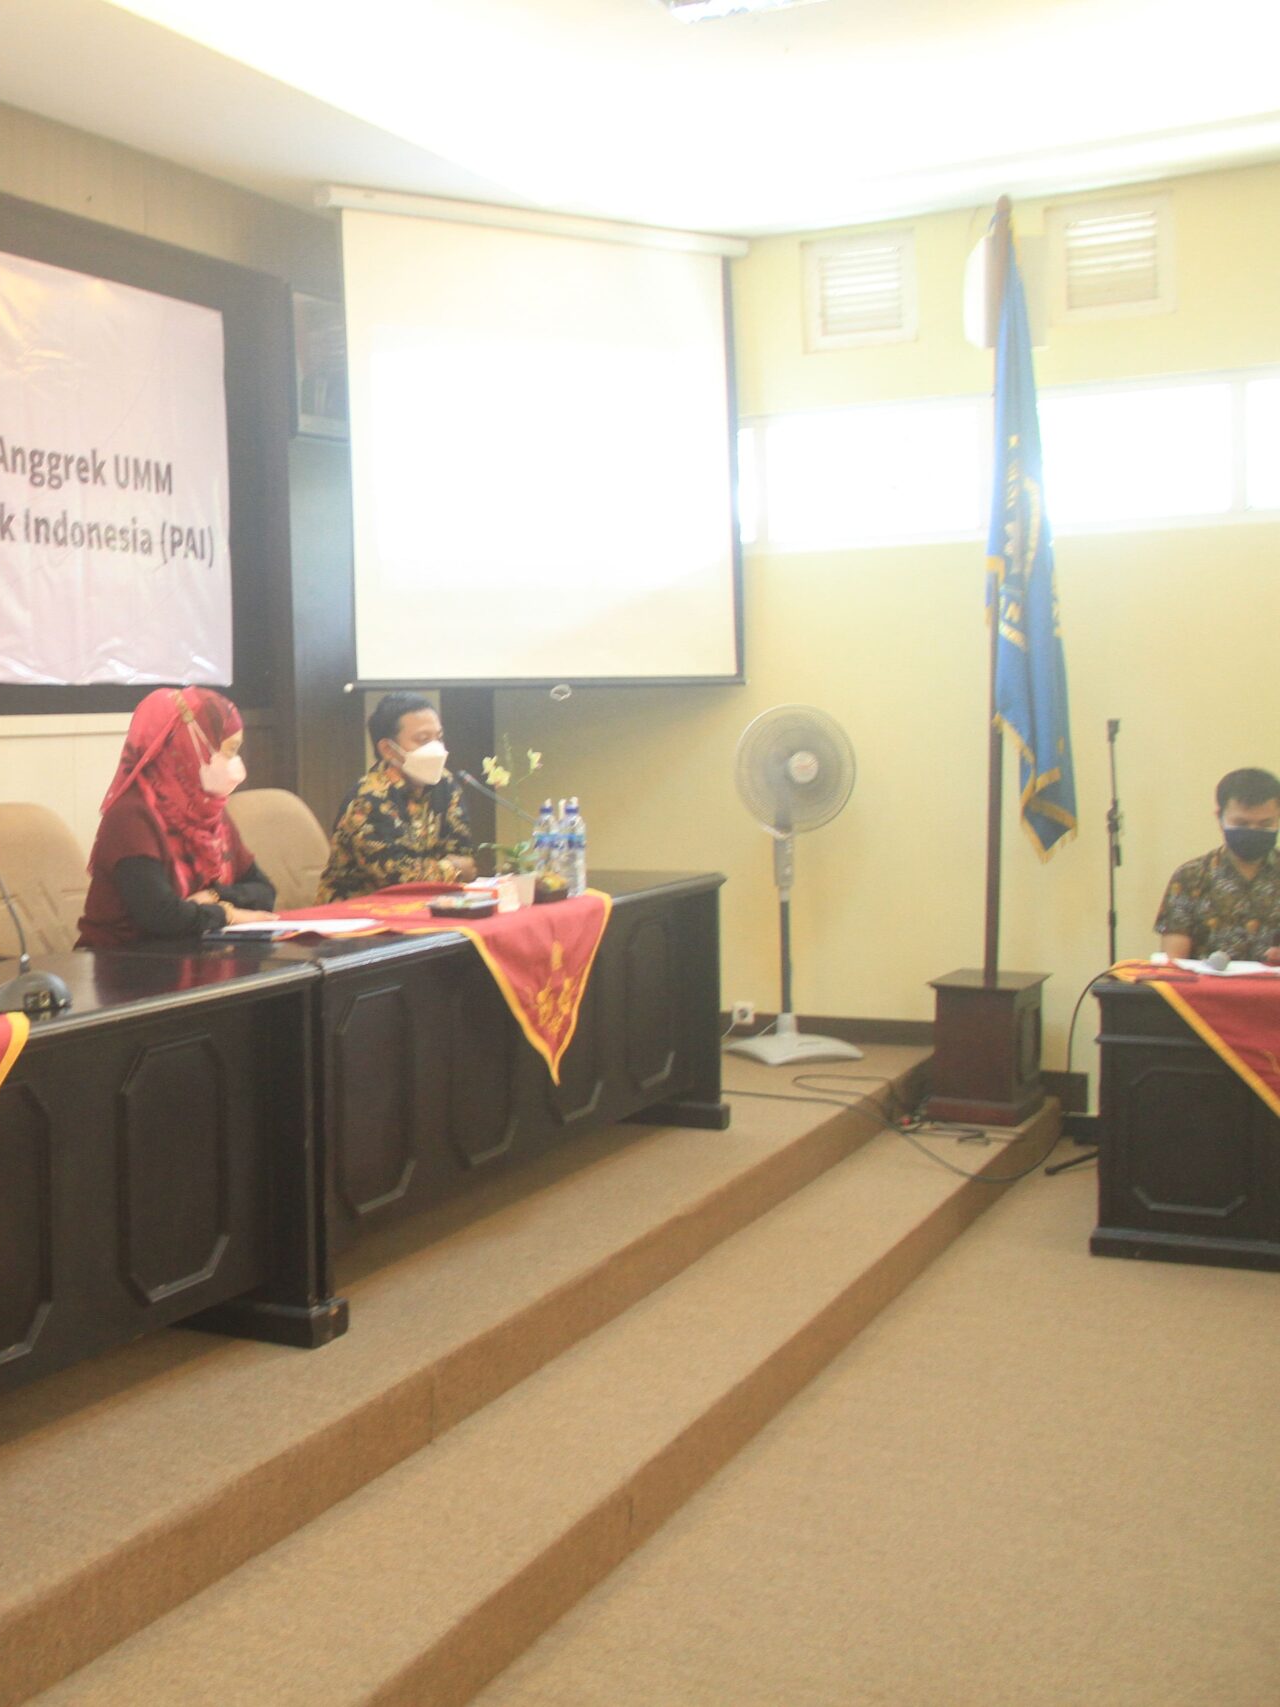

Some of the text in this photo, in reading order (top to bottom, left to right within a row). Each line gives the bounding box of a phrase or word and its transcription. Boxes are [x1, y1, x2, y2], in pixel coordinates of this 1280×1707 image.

[114, 453, 172, 496] UMM
[24, 508, 153, 555] Indonesia
[160, 520, 215, 569] (PAI)
